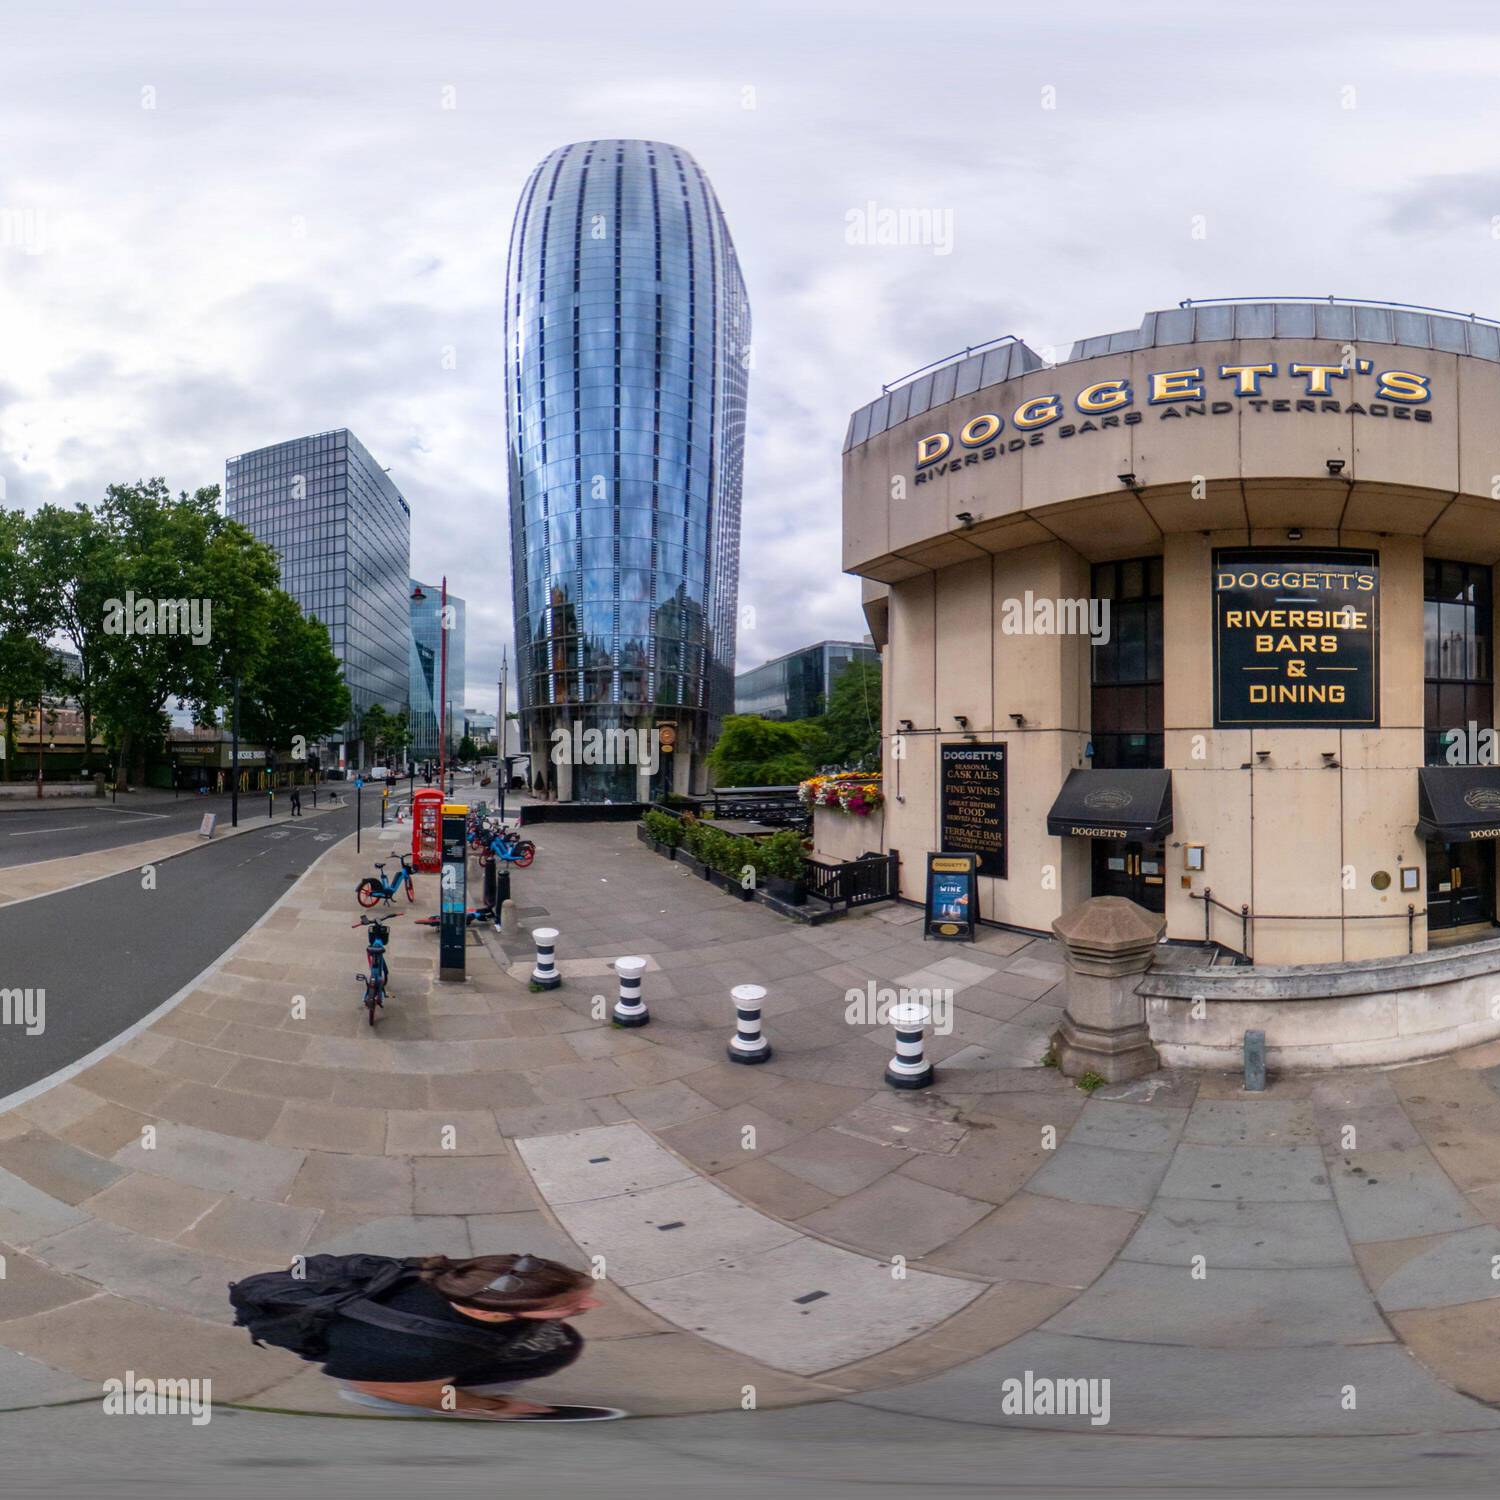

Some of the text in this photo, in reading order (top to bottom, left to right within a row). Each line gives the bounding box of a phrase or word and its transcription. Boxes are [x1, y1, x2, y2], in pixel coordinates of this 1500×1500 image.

[917, 359, 1431, 470] DOGGETT'S
[914, 399, 1432, 486] RIVERSIDE BARS AND TERRACES
[1216, 572, 1375, 591] DOGGETT'S
[1227, 610, 1367, 629] RIVERSIDE
[1256, 635, 1338, 652] BARS
[1287, 659, 1307, 677] &
[1249, 685, 1345, 703] DINING
[944, 751, 1003, 760] DOGGETT'S
[947, 770, 998, 780] CASK ALES
[945, 785, 1000, 796] FINE WINES
[959, 807, 985, 817] FOOD
[945, 827, 1001, 840] TERRACE BAR
[1072, 827, 1127, 838] DOGGETT'S
